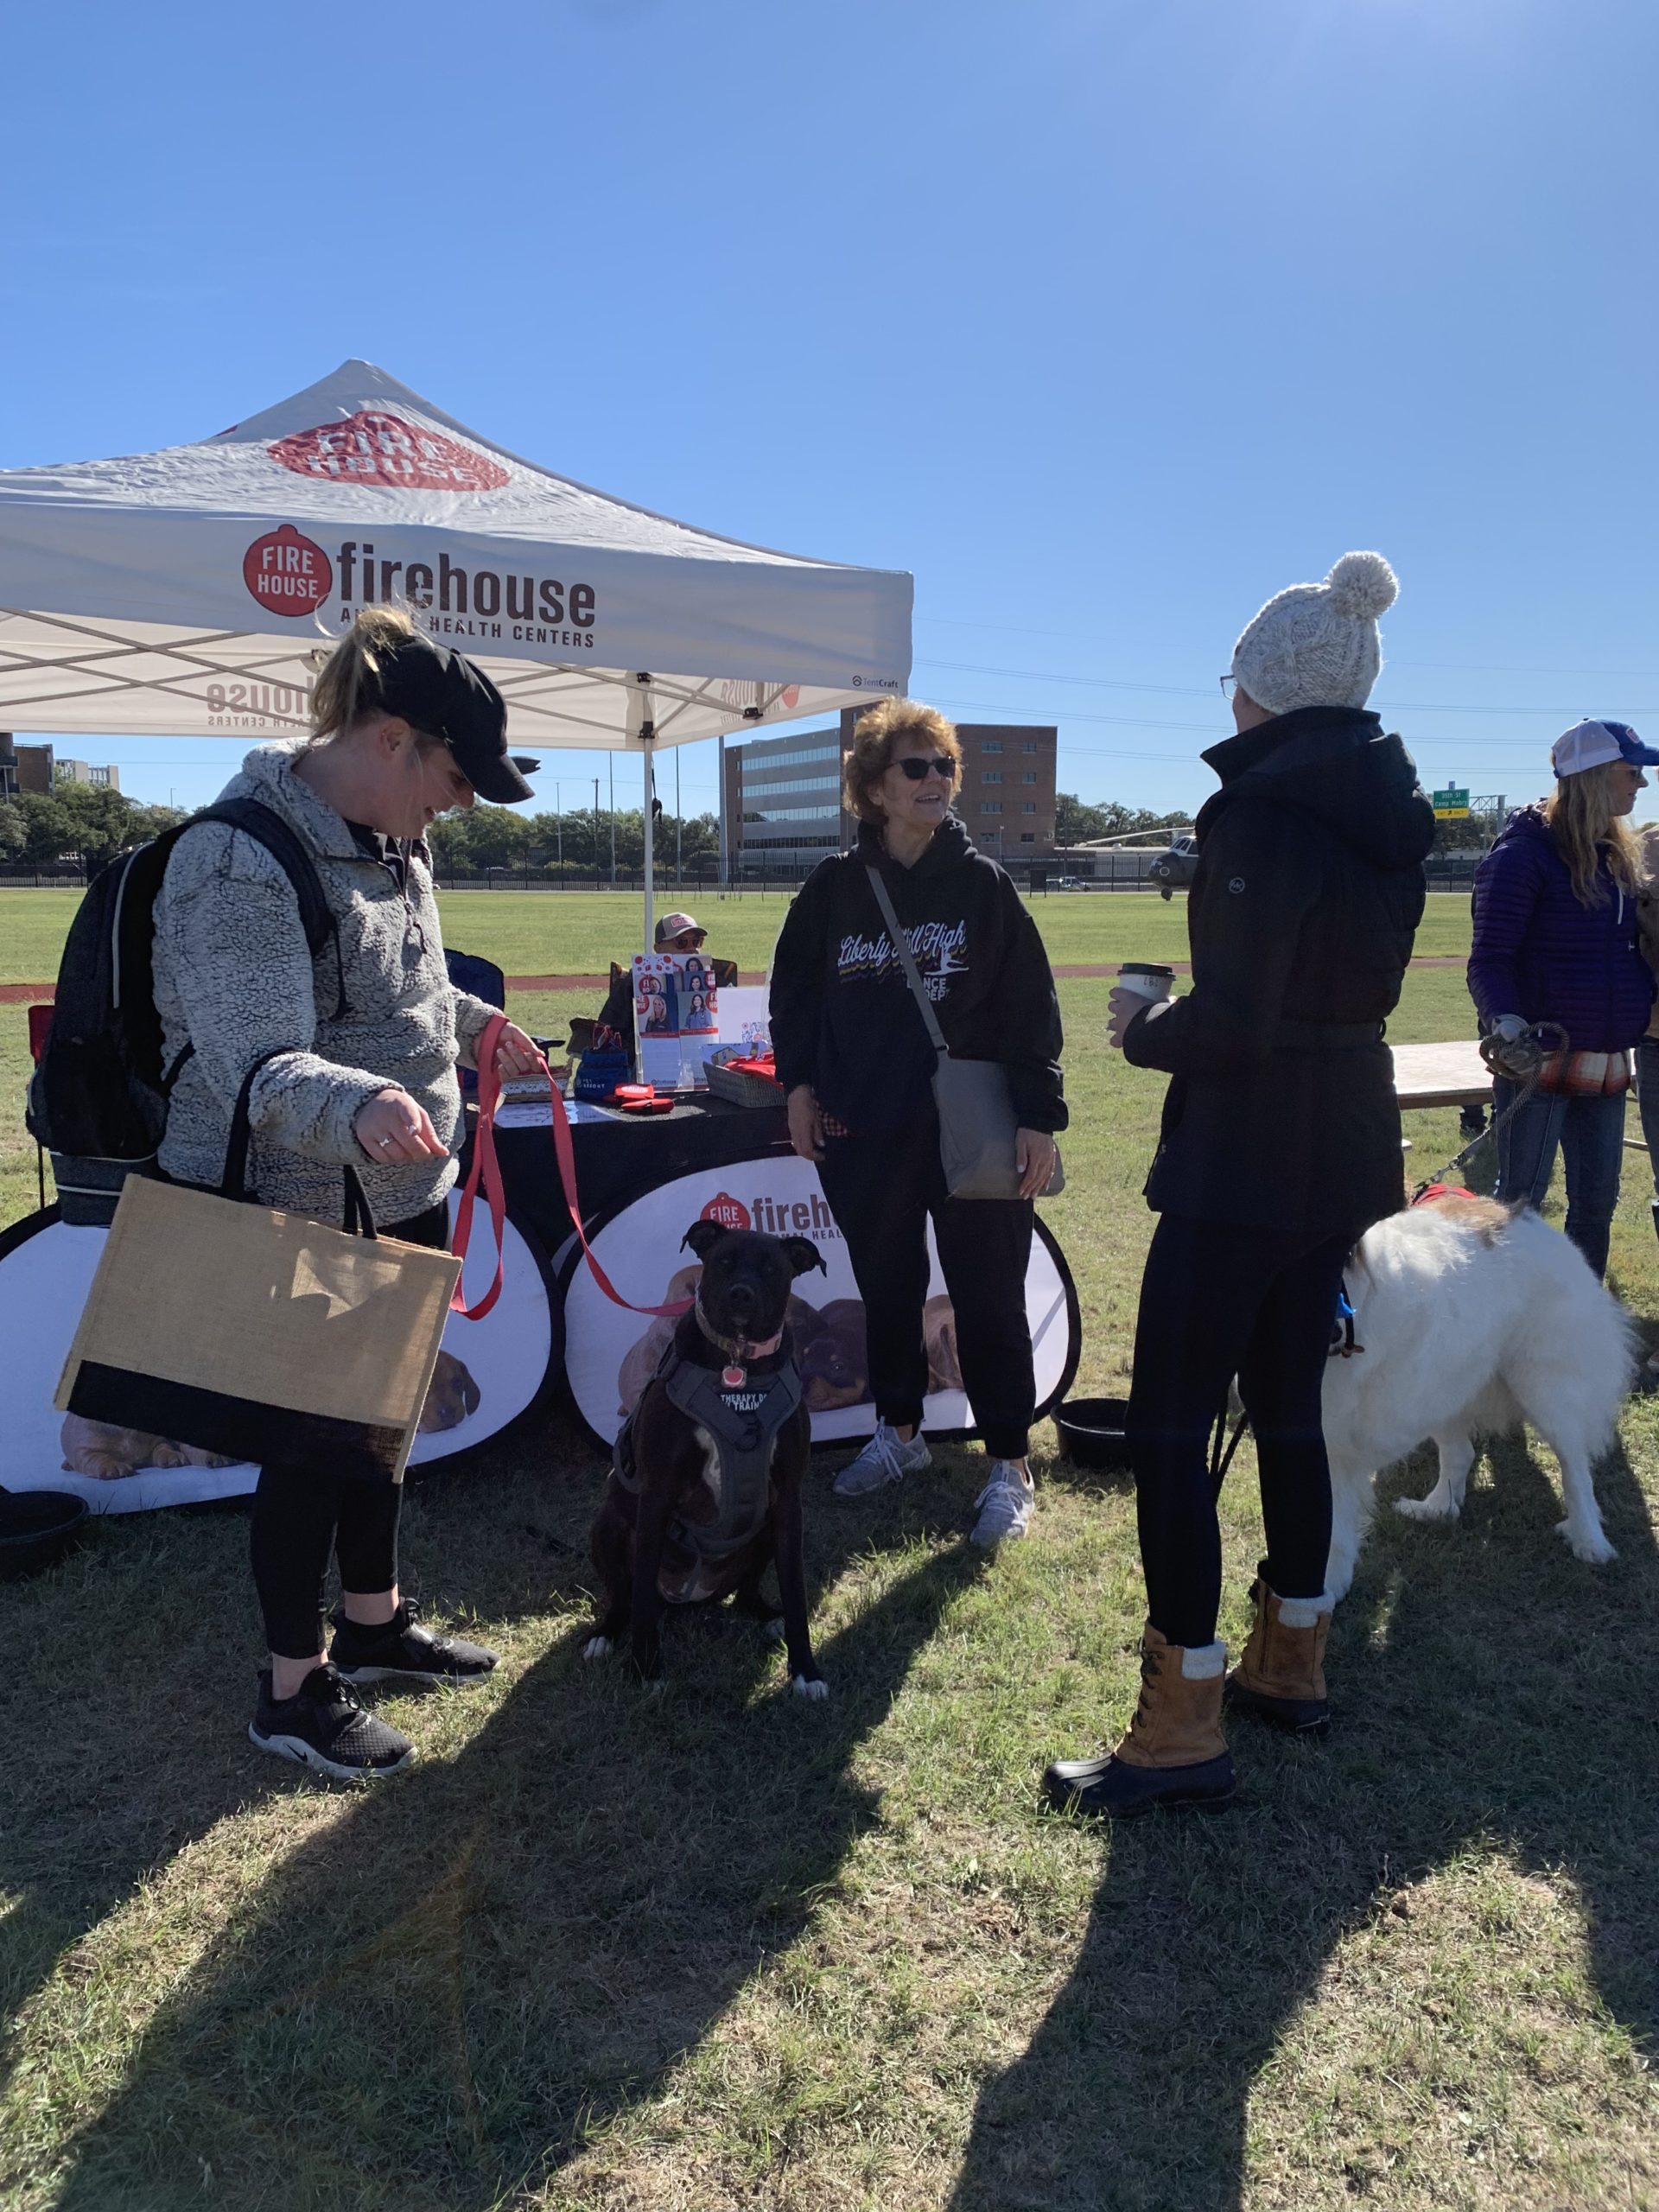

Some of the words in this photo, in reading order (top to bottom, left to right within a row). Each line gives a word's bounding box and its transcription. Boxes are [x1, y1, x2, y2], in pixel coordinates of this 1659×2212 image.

[317, 429, 454, 463] FIRE
[307, 454, 480, 484] HOUSE
[263, 545, 315, 575] FIRE
[257, 574, 318, 600] HOUSE
[337, 542, 595, 628] firehouse
[429, 616, 502, 639] HEALTH
[512, 625, 594, 649] CENTERS
[864, 677, 899, 689] TentCraft
[838, 931, 891, 967] Liberty
[891, 925, 925, 956] ill
[923, 919, 966, 957] High
[907, 977, 947, 990] NCE
[709, 1206, 740, 1222] FIRE
[751, 1194, 830, 1233] fireh
[812, 1229, 842, 1240] HEAL
[720, 1394, 756, 1403] THERAPY
[734, 1401, 760, 1411] TRAIN
